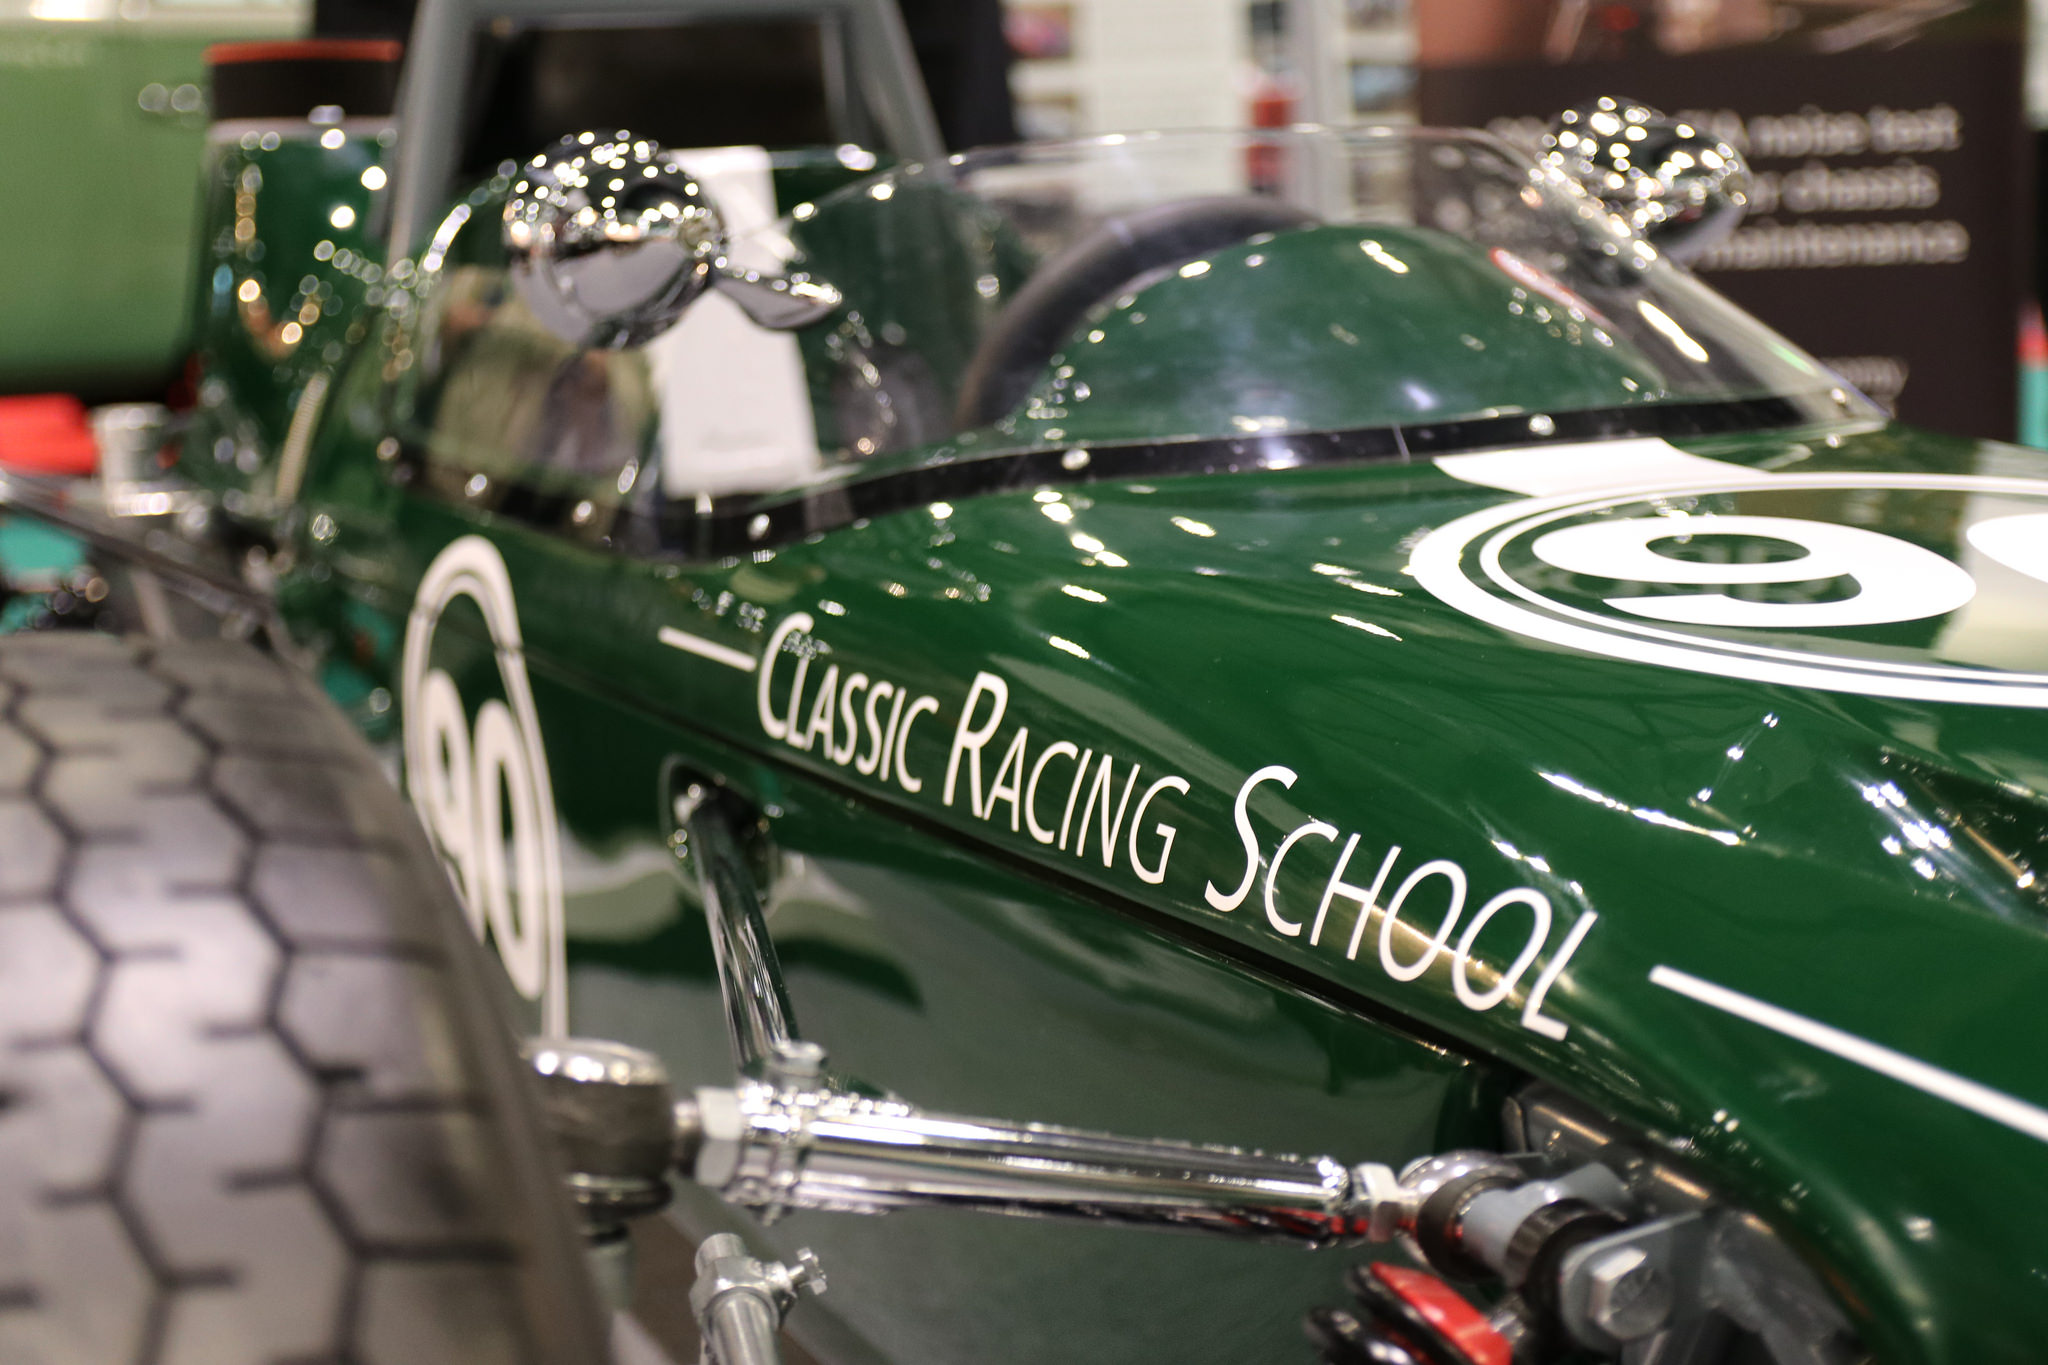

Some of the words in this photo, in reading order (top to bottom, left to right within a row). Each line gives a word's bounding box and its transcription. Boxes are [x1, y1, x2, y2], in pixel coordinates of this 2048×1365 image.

[757, 611, 939, 793] CLASSIC
[943, 670, 1191, 885] RACING
[1204, 764, 1598, 1041] SCHOOL
